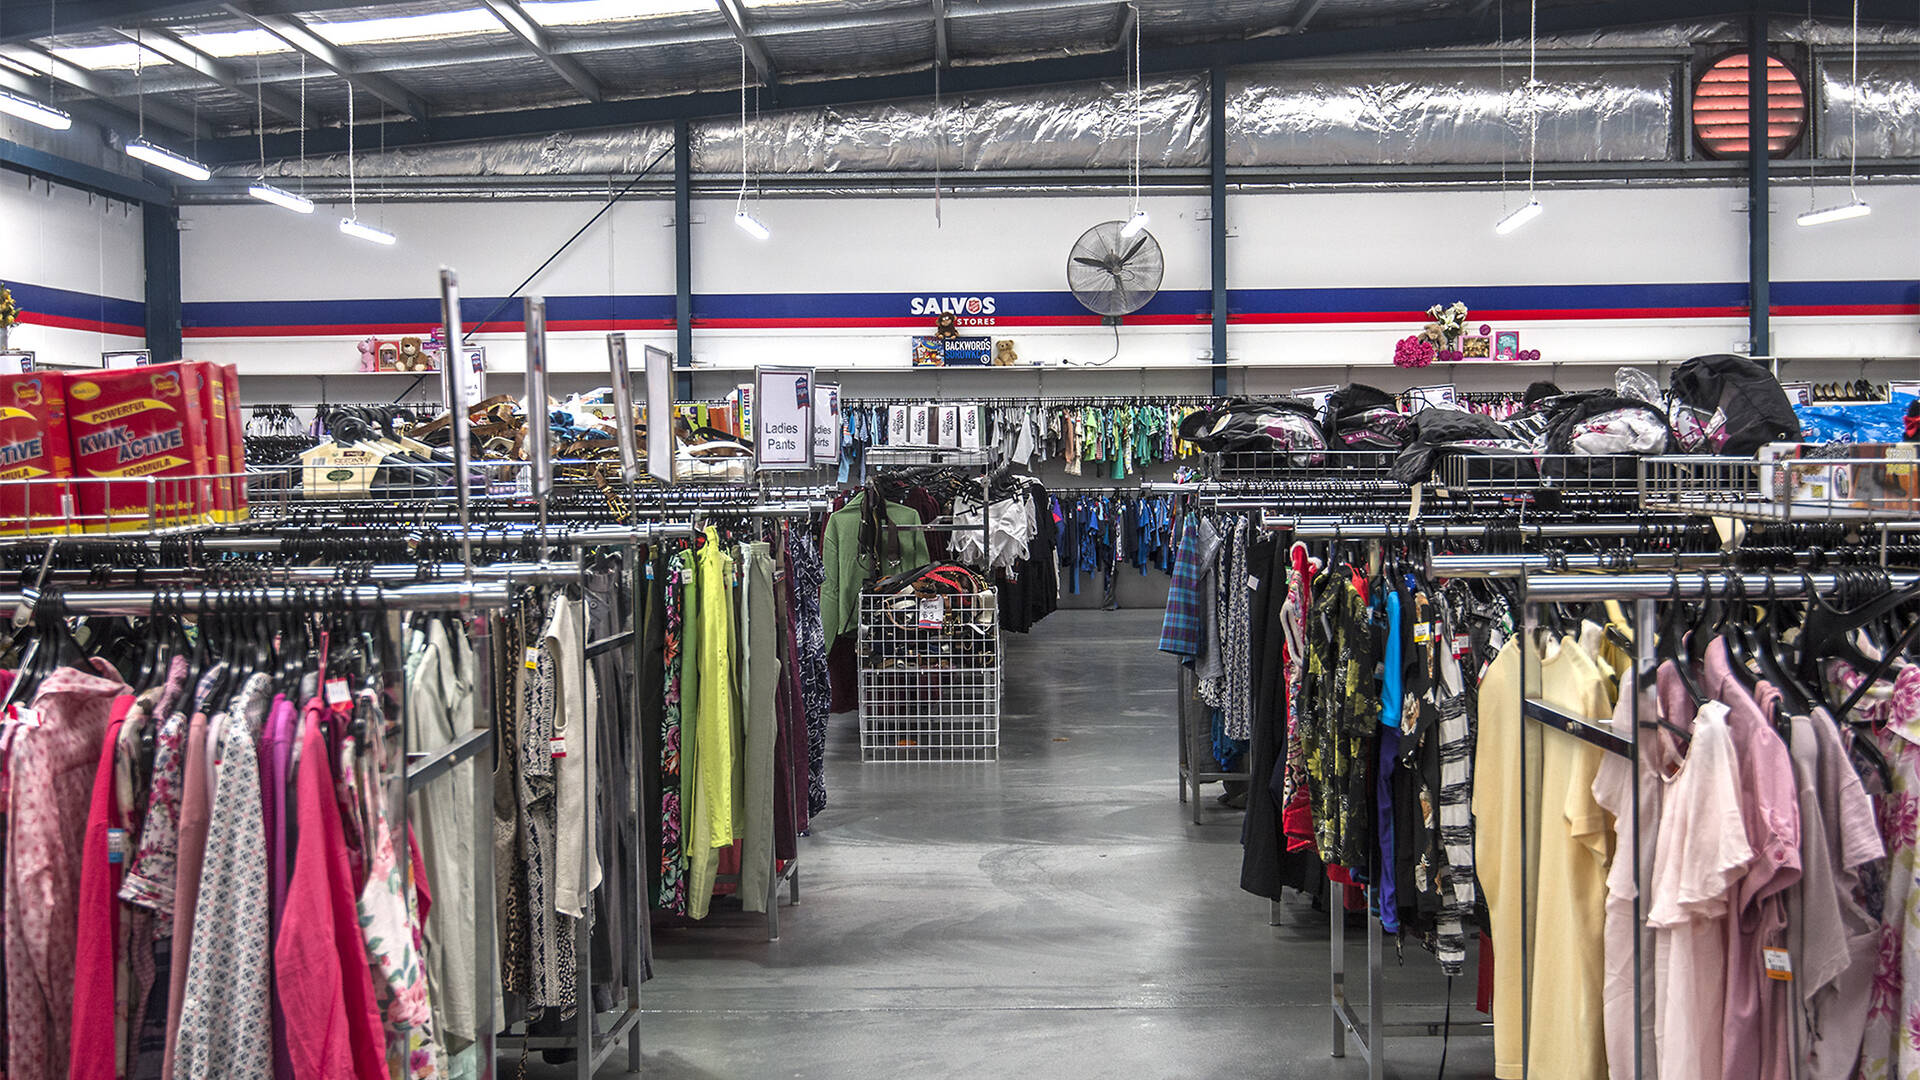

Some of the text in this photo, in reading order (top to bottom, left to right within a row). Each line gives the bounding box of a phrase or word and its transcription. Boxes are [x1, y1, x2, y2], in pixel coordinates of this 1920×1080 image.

[911, 297, 996, 315] SALVOS
[956, 318, 996, 326] STORES
[91, 400, 147, 423] POWERFUL
[743, 388, 751, 416] BUILD
[765, 422, 798, 434] Ladies
[0, 437, 43, 466] TIVE
[118, 427, 183, 464] ACTIVE
[768, 438, 796, 451] Pants
[814, 437, 830, 448] kirts
[122, 458, 172, 478] FORMULA
